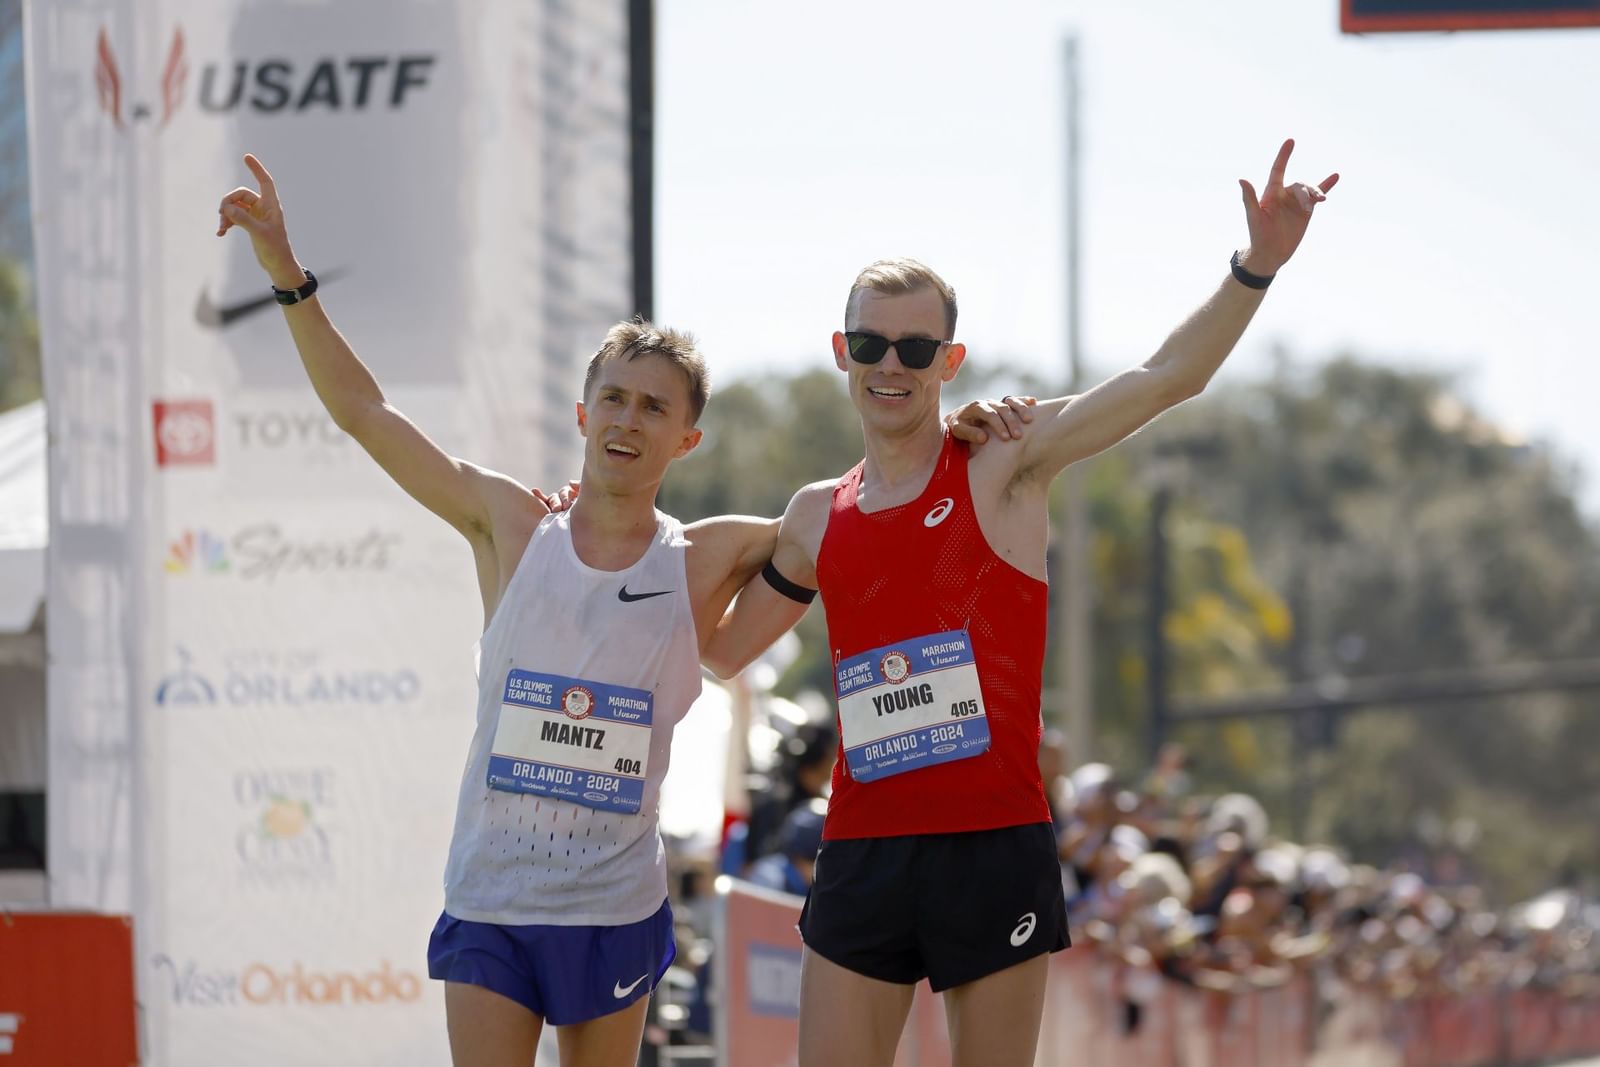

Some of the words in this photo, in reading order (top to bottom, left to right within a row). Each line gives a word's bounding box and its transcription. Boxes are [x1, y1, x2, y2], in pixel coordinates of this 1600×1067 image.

[197, 55, 435, 113] USATF
[233, 411, 348, 449] TOYO
[922, 640, 966, 657] MARATHON
[838, 670, 847, 681] U.S.
[847, 662, 871, 677] OLYMPIC
[839, 677, 853, 691] TEAM
[852, 672, 874, 686] TRIALS
[225, 669, 420, 706] ORLANDO
[507, 689, 526, 701] TEAM
[526, 693, 552, 705] TRIALS
[509, 678, 523, 688] U.S.
[523, 680, 552, 693] OLYMPIC
[608, 696, 648, 711] MARATHON
[872, 683, 934, 717] YOUNG
[951, 699, 978, 717] 405
[541, 720, 606, 750] MANTZ
[865, 734, 918, 761] ORLANDO
[930, 724, 964, 744] 2024
[512, 762, 574, 785] ORLANDO
[586, 774, 621, 793] 2024
[614, 757, 641, 775] 404
[240, 959, 421, 1006] Orlando
